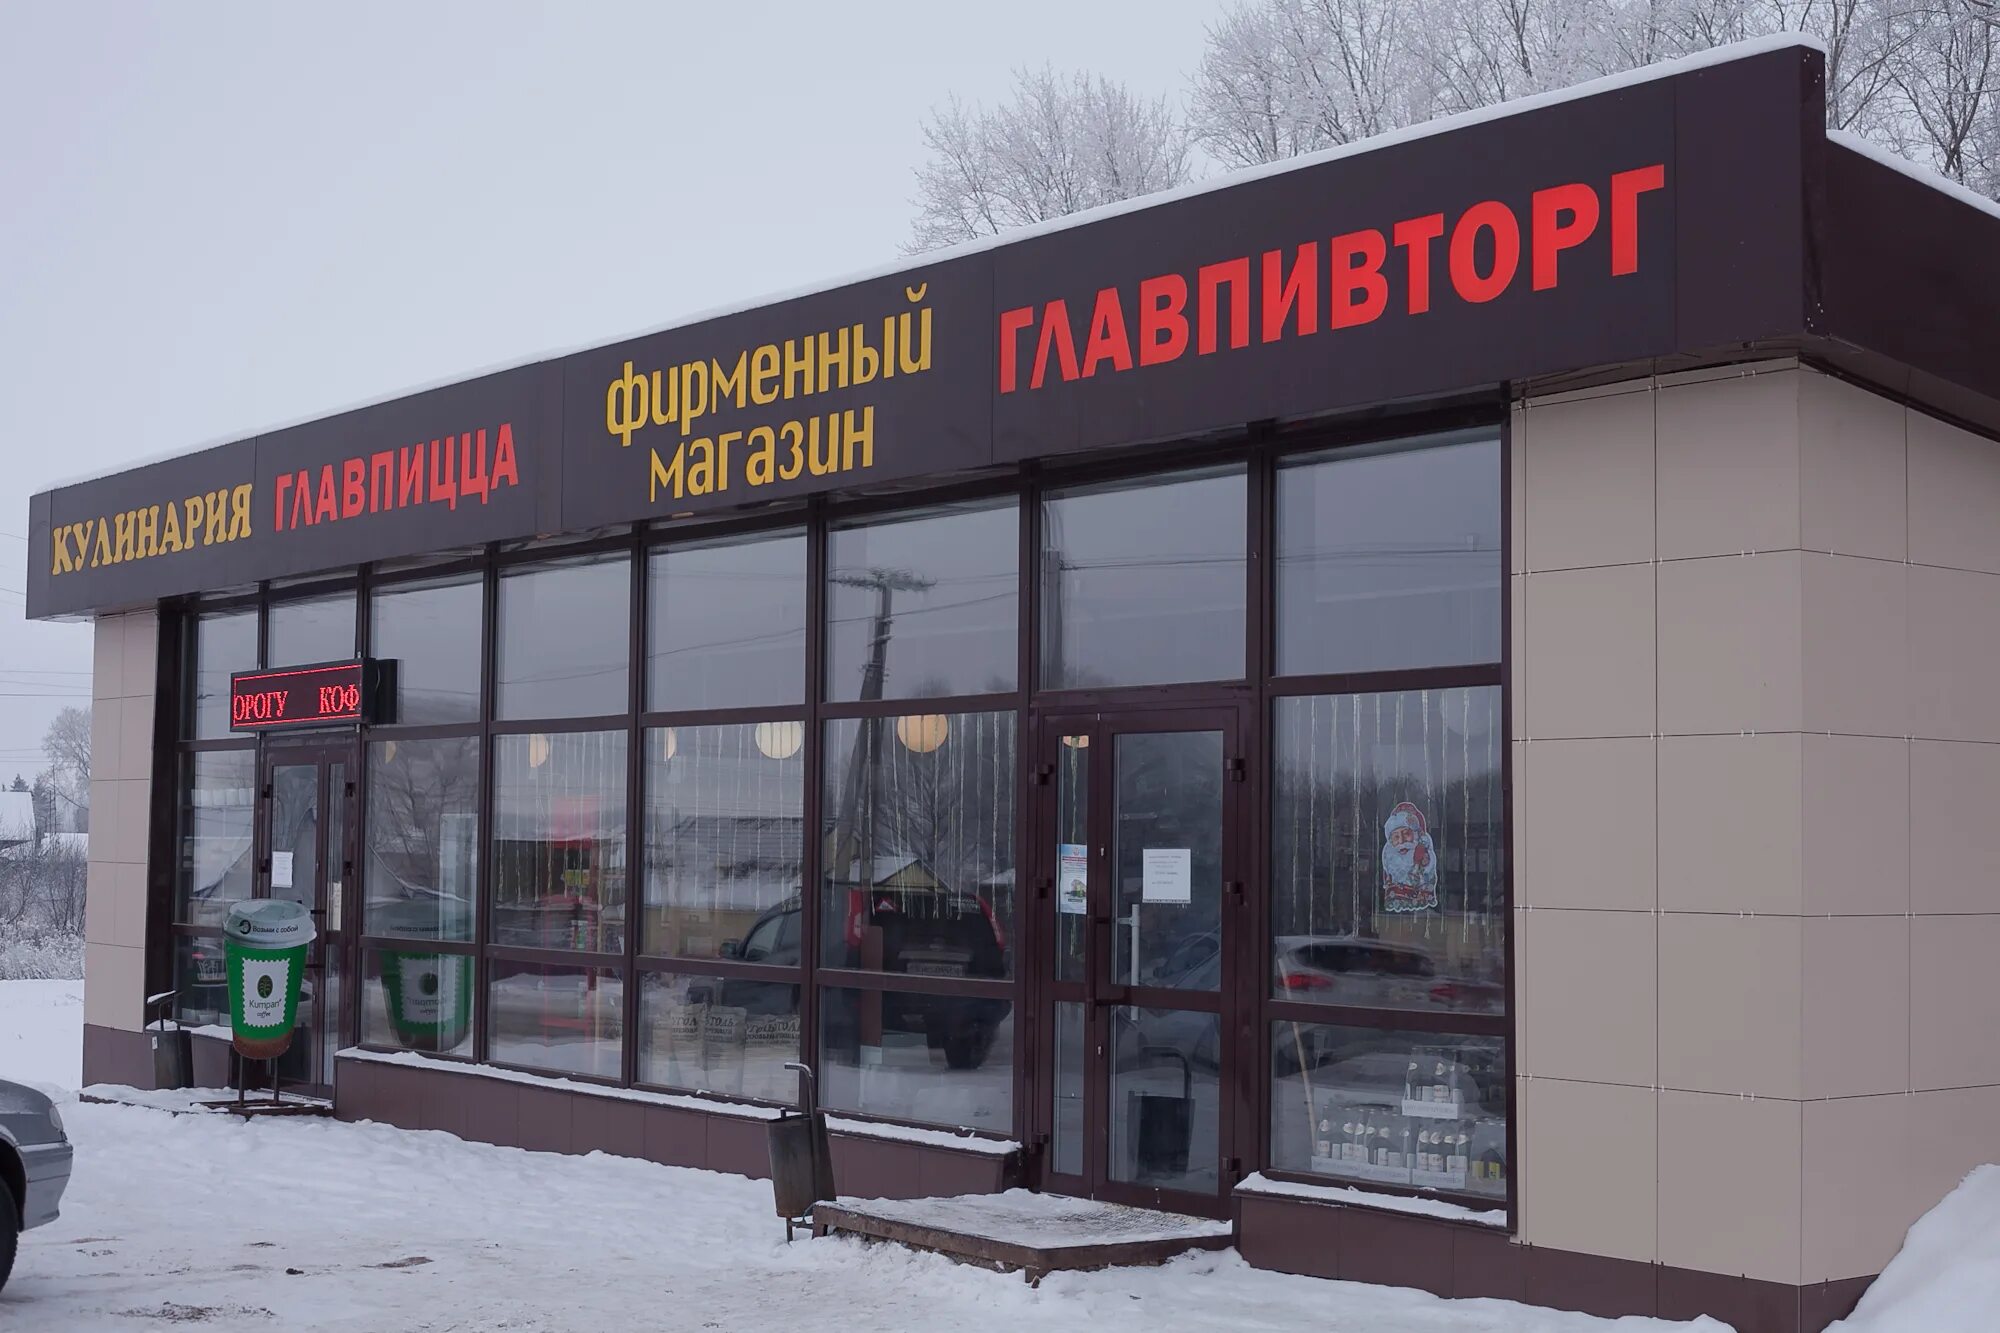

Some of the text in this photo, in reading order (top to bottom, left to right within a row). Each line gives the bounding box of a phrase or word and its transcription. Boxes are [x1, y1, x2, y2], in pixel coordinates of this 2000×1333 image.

[999, 163, 1665, 395] ГЛАВПИВТОРГ
[606, 282, 932, 447] фирменный
[274, 423, 519, 532] ГЛАВПИЦЦА
[650, 406, 875, 503] магазин
[51, 483, 253, 575] КУЛИНАРИЯ
[234, 684, 360, 720] ОРОГУ КОФ
